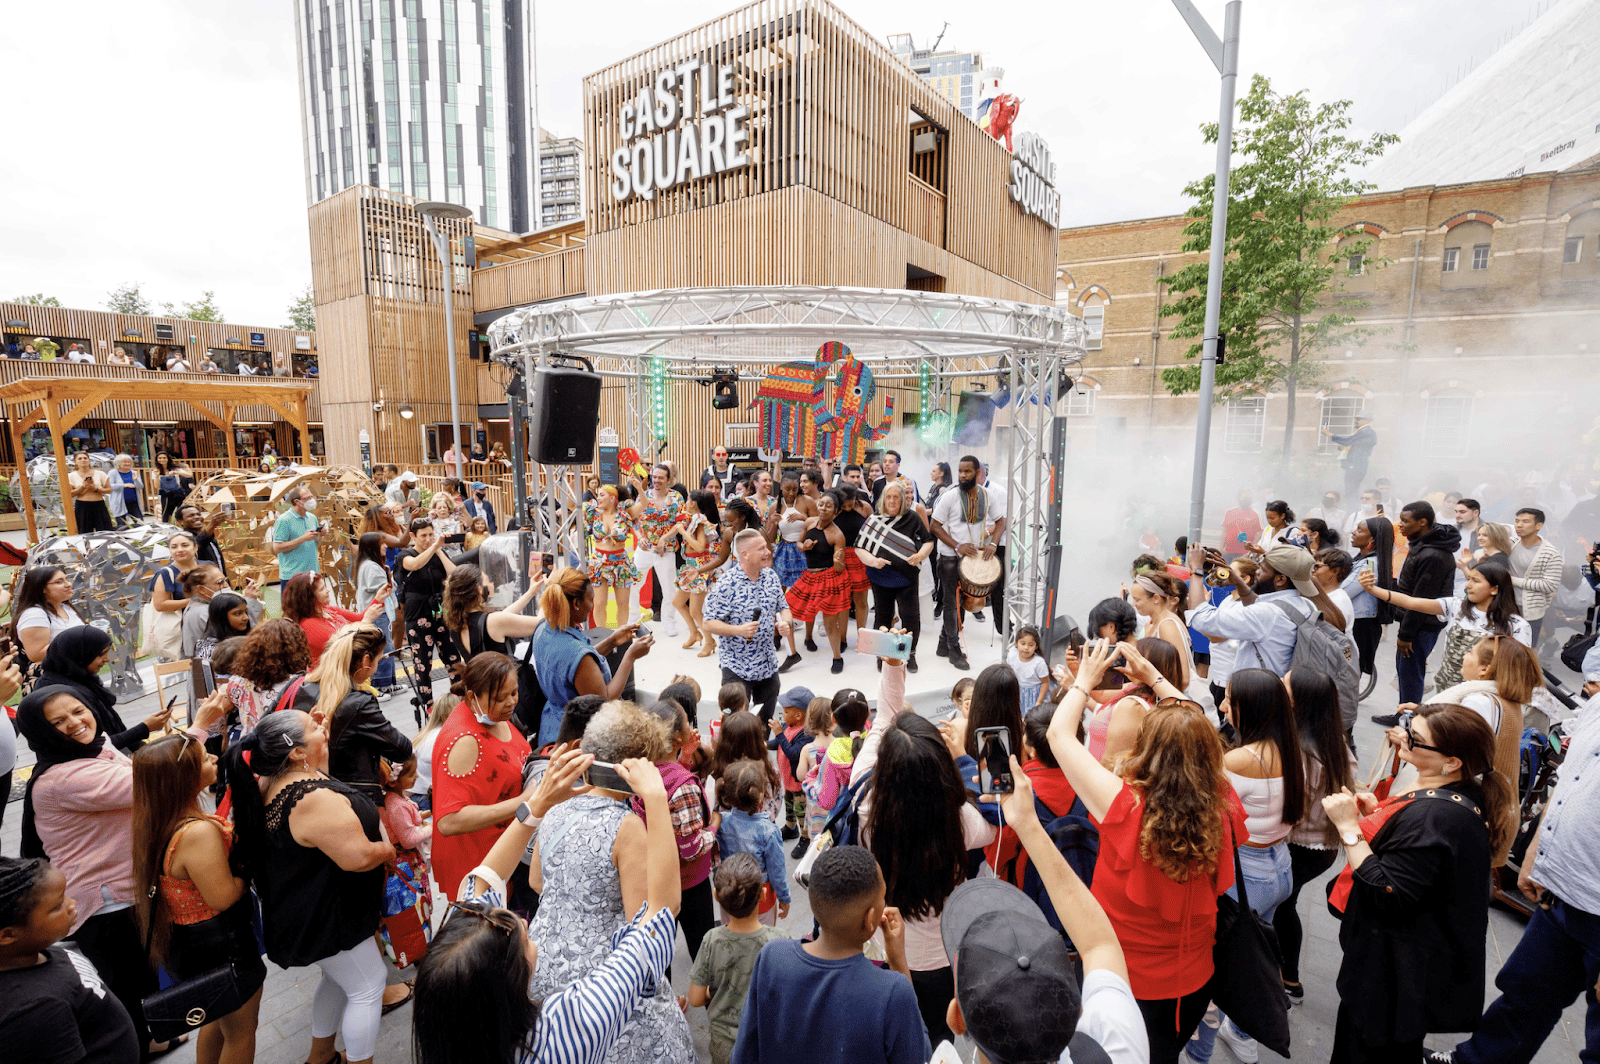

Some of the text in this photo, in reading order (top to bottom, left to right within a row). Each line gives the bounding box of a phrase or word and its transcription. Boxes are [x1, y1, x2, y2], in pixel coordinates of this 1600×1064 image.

[620, 58, 737, 141] CASTLE
[611, 106, 750, 202] SQUARE
[1016, 131, 1057, 188] CASTLE
[1545, 139, 1577, 159] keltbray
[1010, 160, 1059, 229] SQUARE
